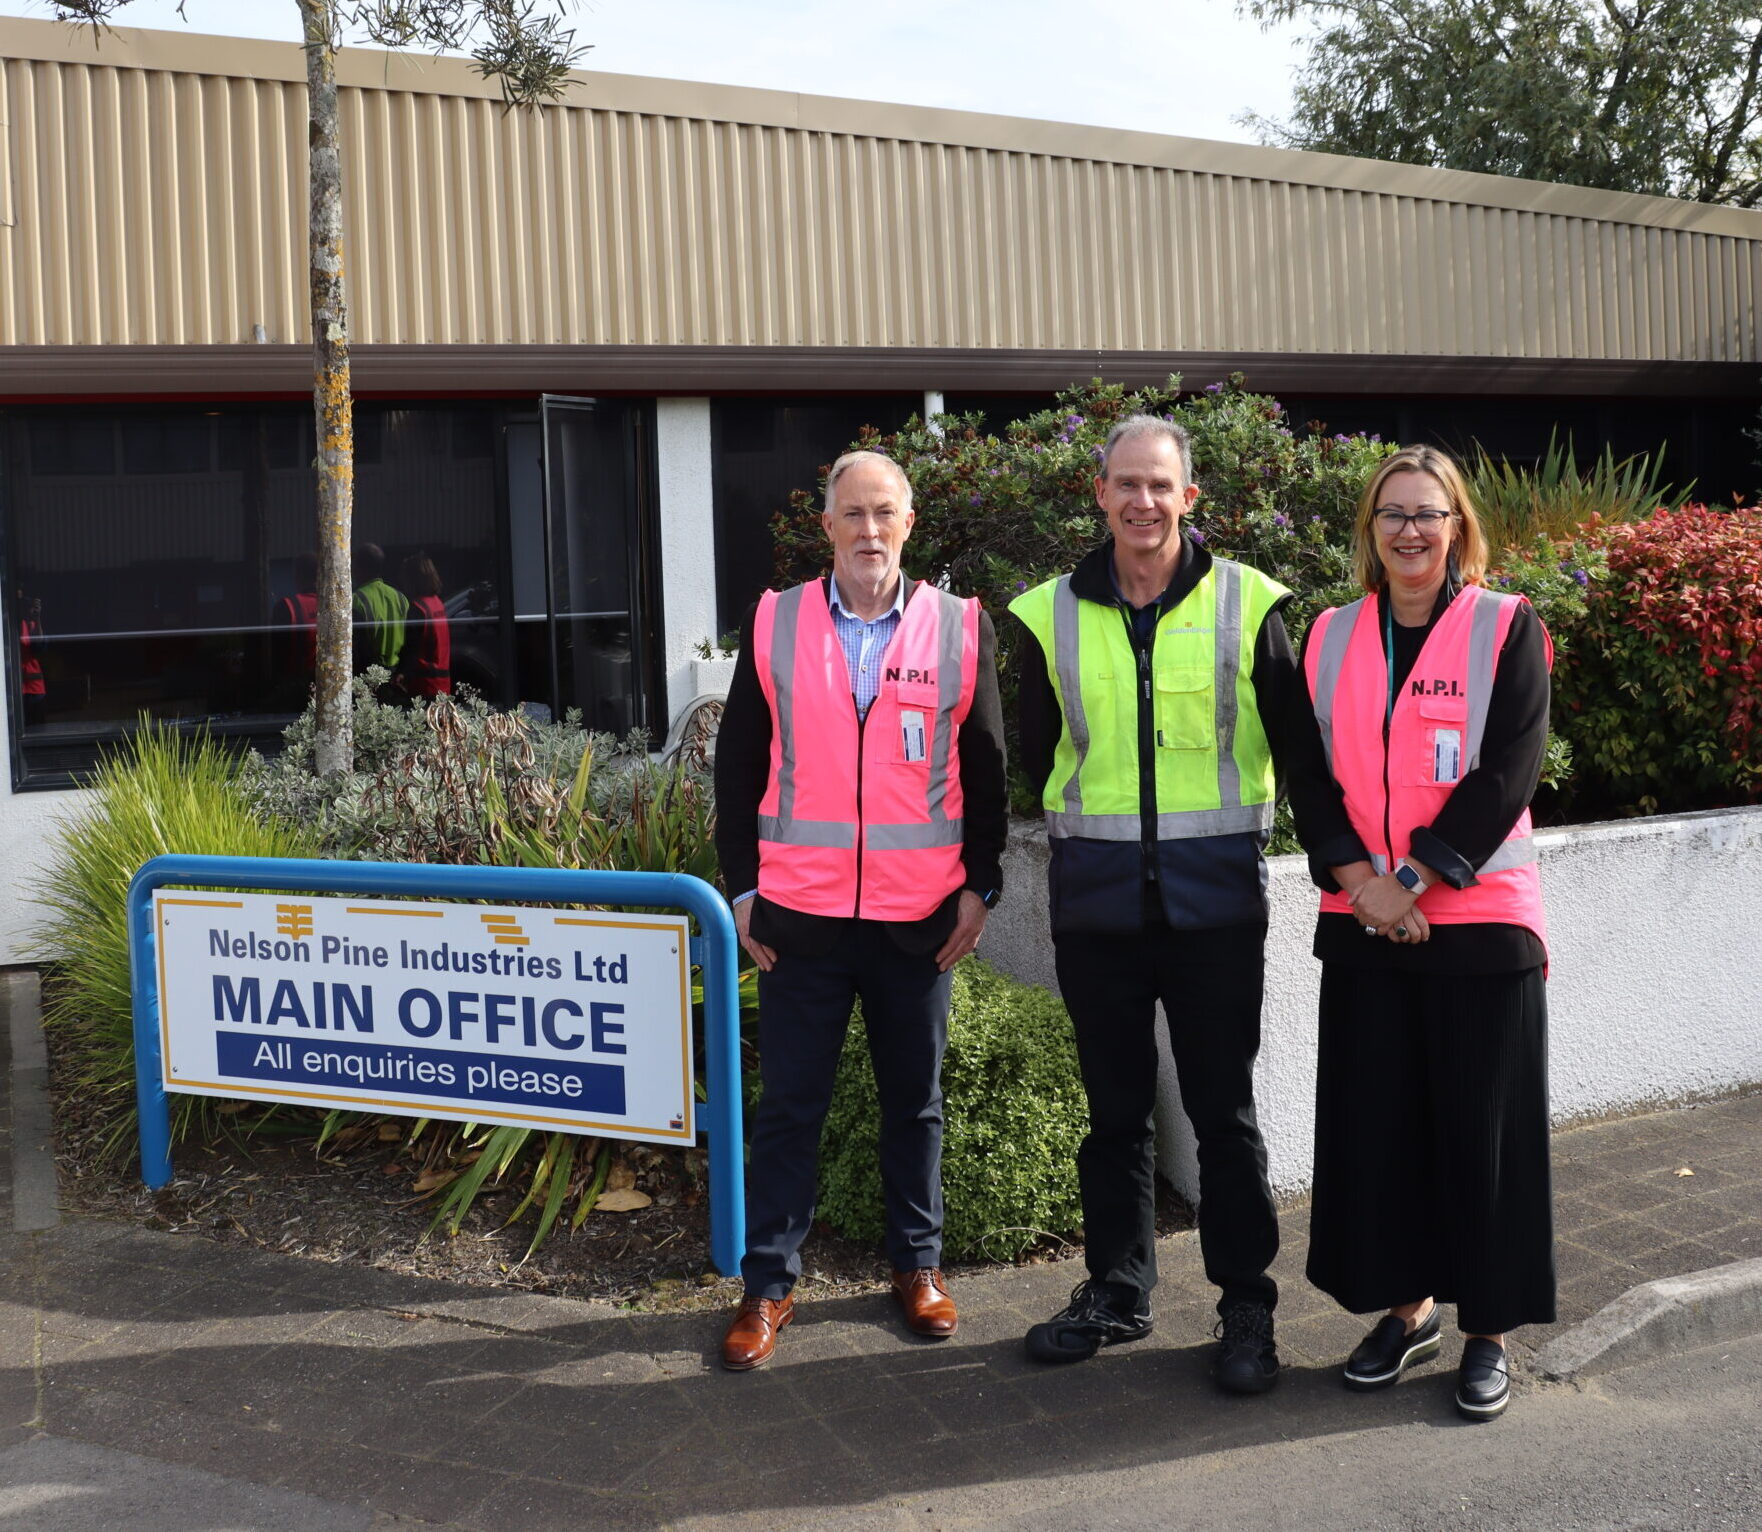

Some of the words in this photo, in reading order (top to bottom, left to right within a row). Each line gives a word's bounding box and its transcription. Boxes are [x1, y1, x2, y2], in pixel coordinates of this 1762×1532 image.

[886, 668, 935, 685] N.P.I.
[1411, 679, 1464, 697] N.P.I.
[209, 928, 311, 964] Nelson
[321, 935, 389, 969] Pine
[400, 940, 563, 981] Industries
[574, 950, 629, 985] Ltd
[213, 974, 375, 1034] MAIN
[398, 987, 628, 1056] OFFICE
[253, 1041, 292, 1070] All
[303, 1050, 456, 1085] enquiries
[467, 1061, 583, 1098] please
